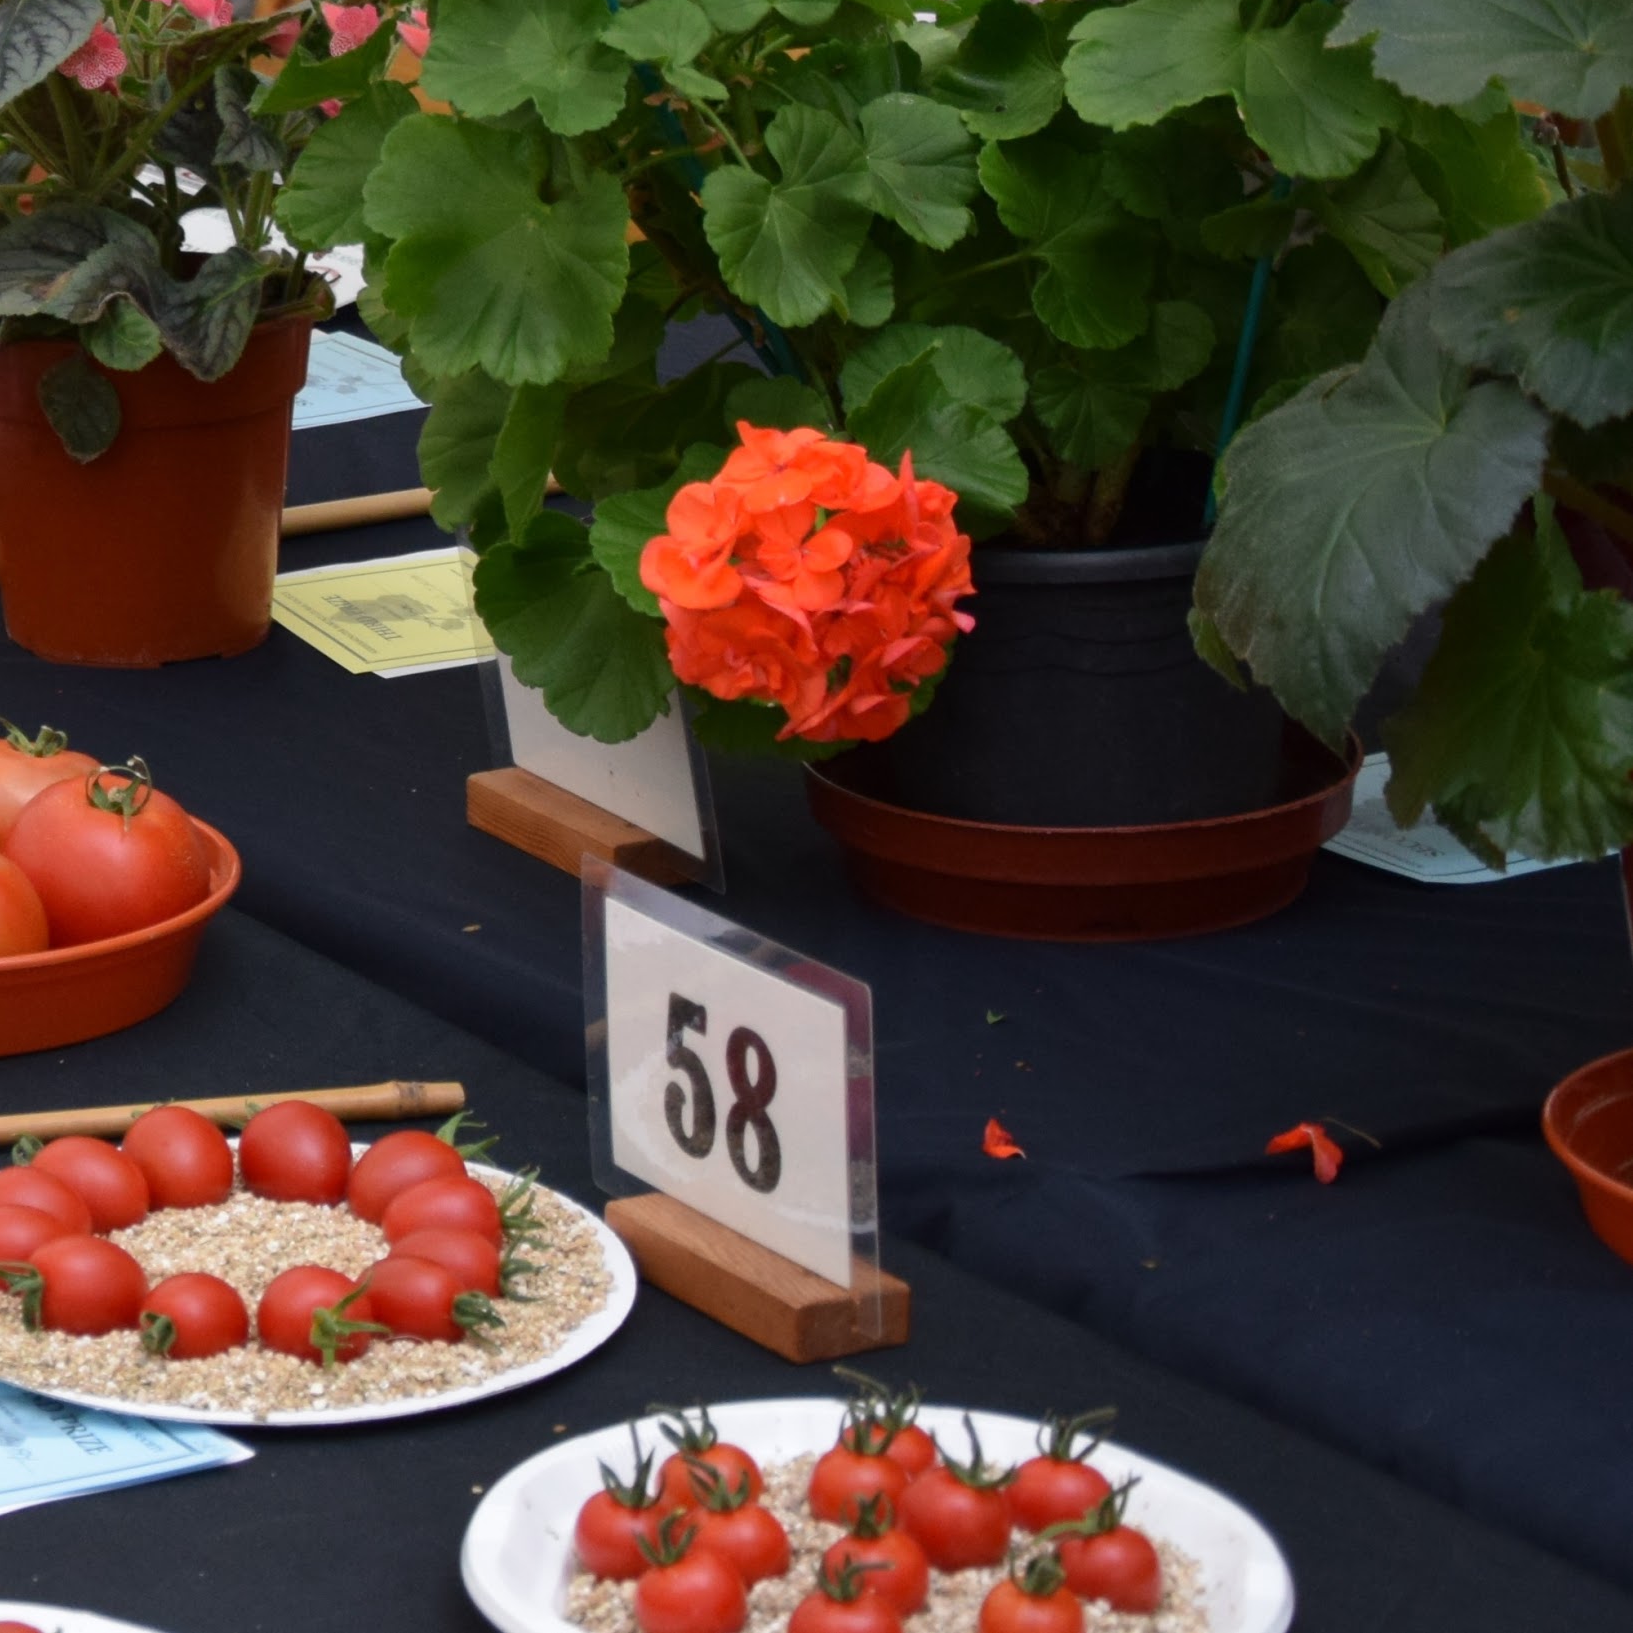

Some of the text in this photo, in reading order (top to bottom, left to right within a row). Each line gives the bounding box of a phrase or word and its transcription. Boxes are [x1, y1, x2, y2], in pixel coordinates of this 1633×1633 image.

[357, 615, 403, 639] THIRD
[664, 992, 782, 1194] 58
[51, 1413, 110, 1455] PRIZE
